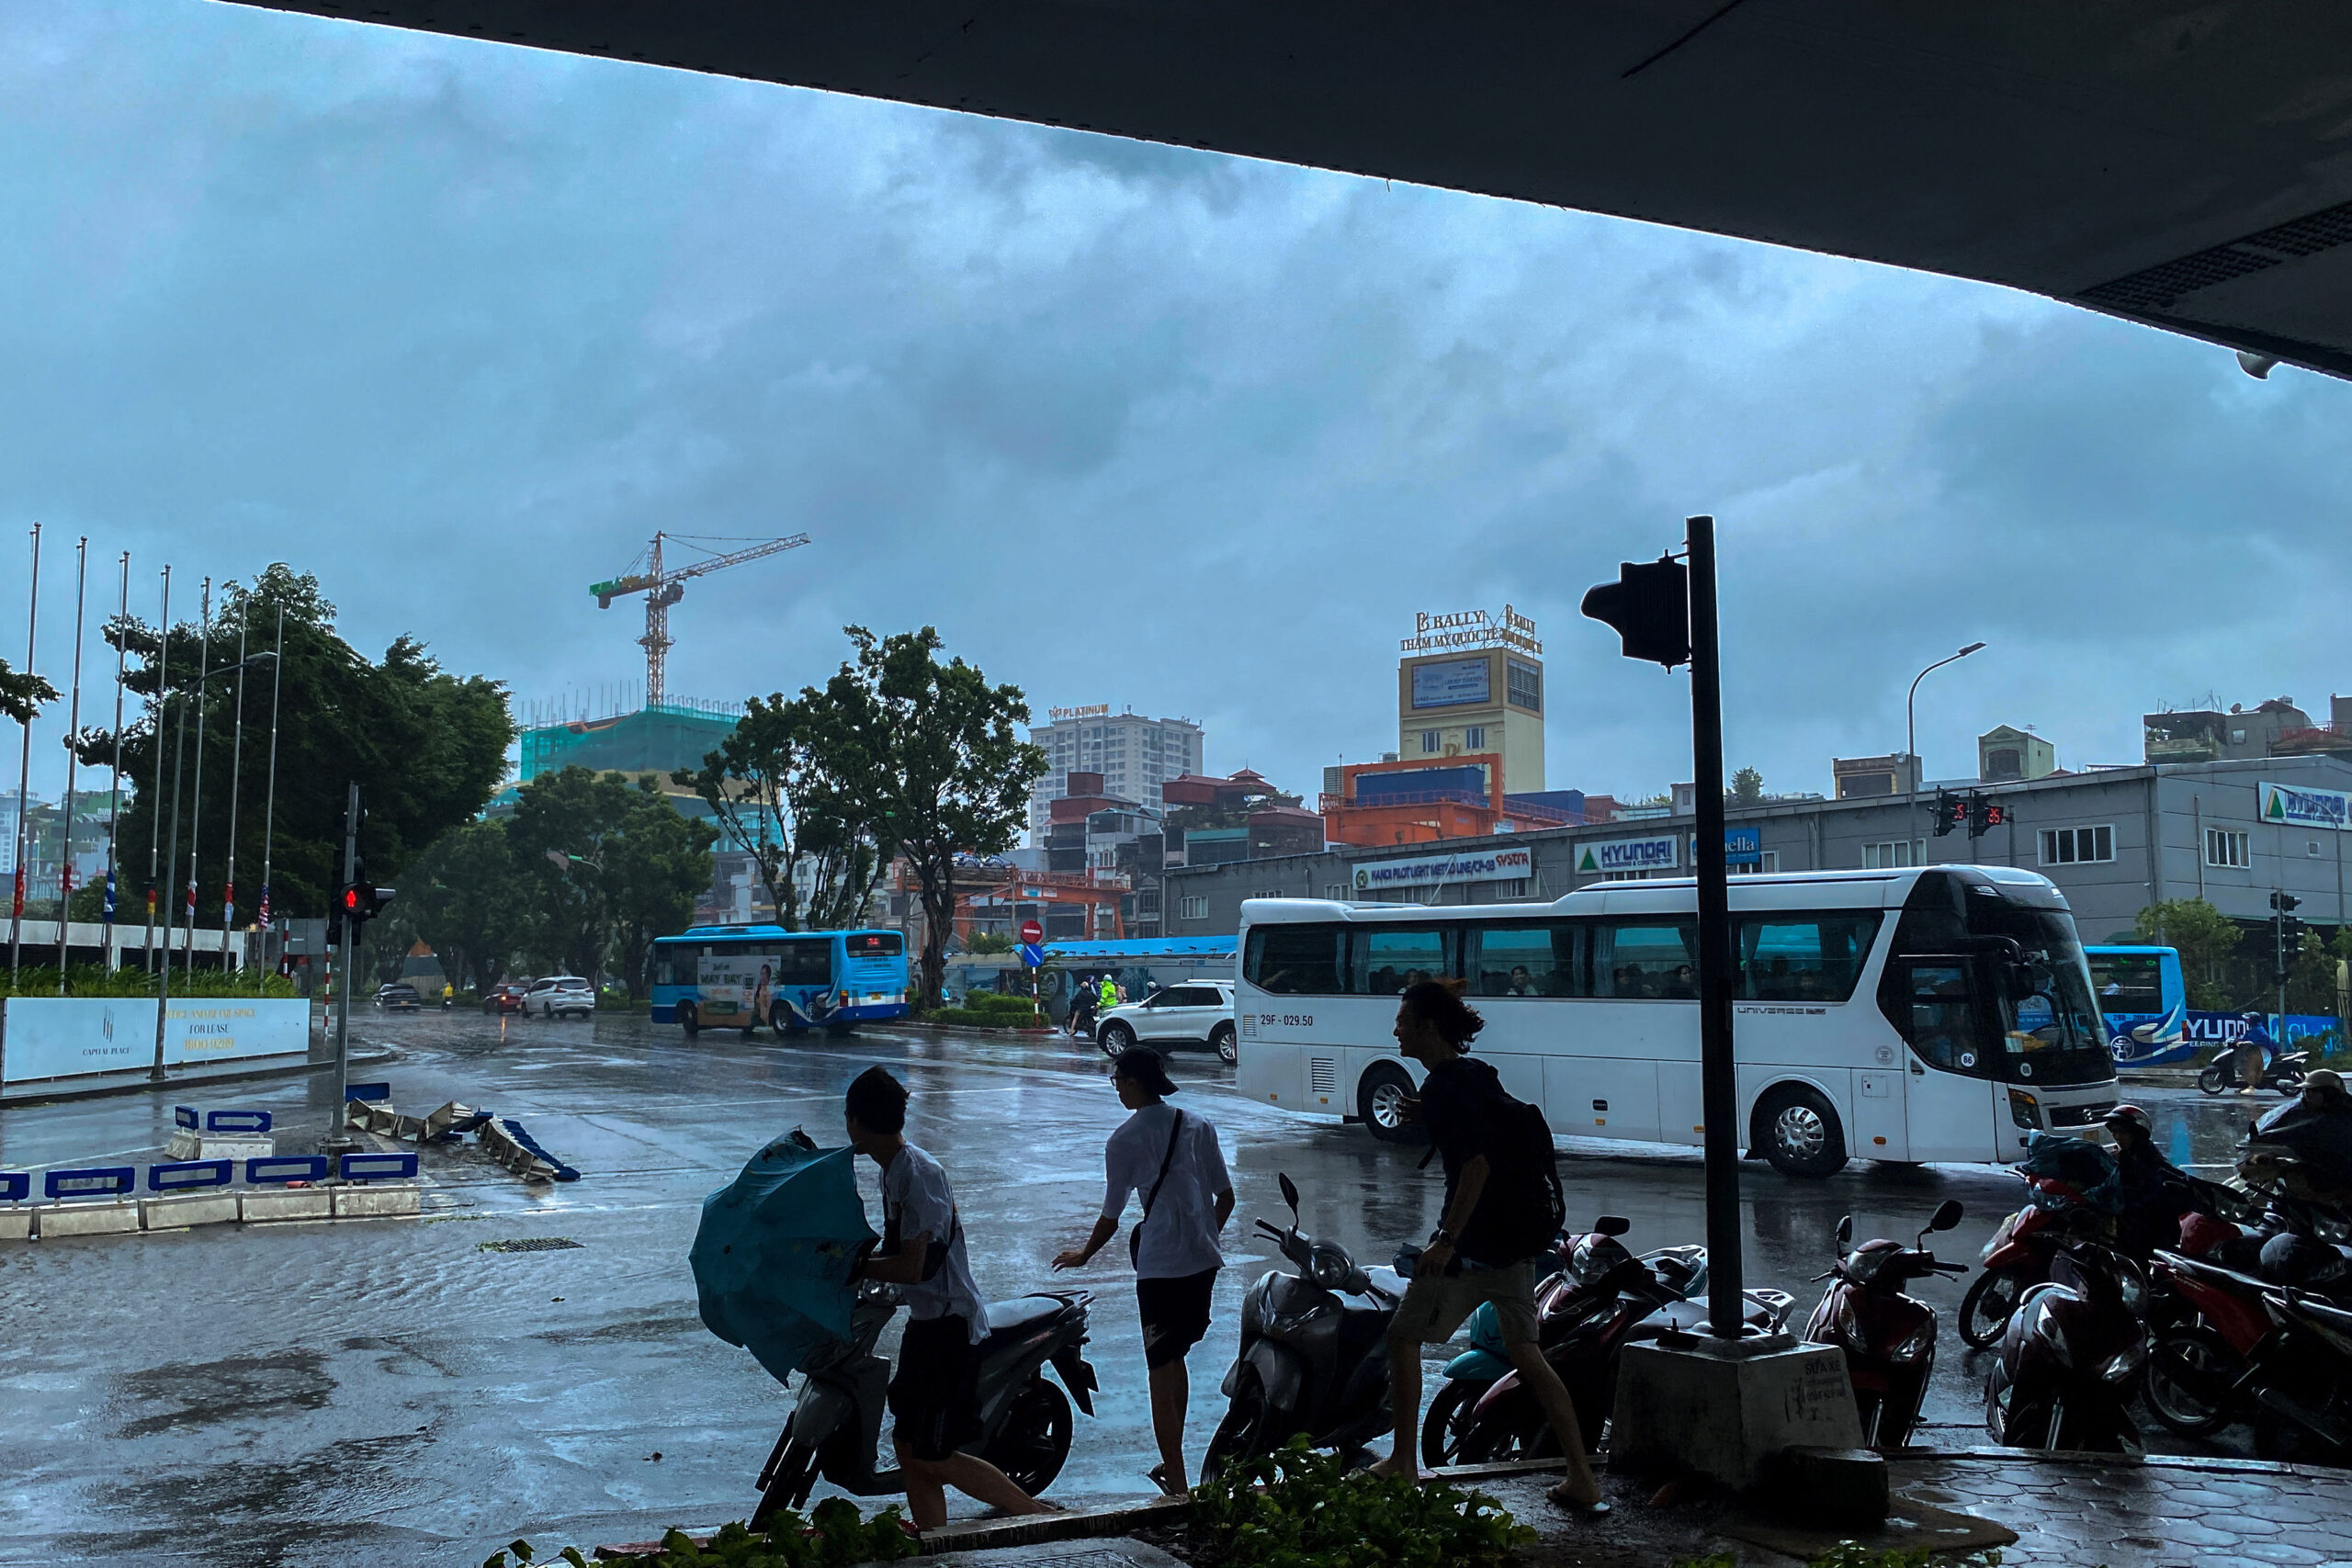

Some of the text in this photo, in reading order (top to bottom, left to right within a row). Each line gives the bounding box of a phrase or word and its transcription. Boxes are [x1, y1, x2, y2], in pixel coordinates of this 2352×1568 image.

[1433, 610, 1484, 628] BALLY
[1063, 704, 1108, 717] PLATINUM
[1725, 837, 1755, 852] ella
[1601, 840, 1672, 862] HYUNDAI
[1737, 1007, 1804, 1015] UNIVERSE
[1261, 1014, 1275, 1025] 29F
[1283, 1015, 1313, 1026] 029.50
[189, 1023, 229, 1034] FOR LEASE
[1963, 1055, 1973, 1064] 86
